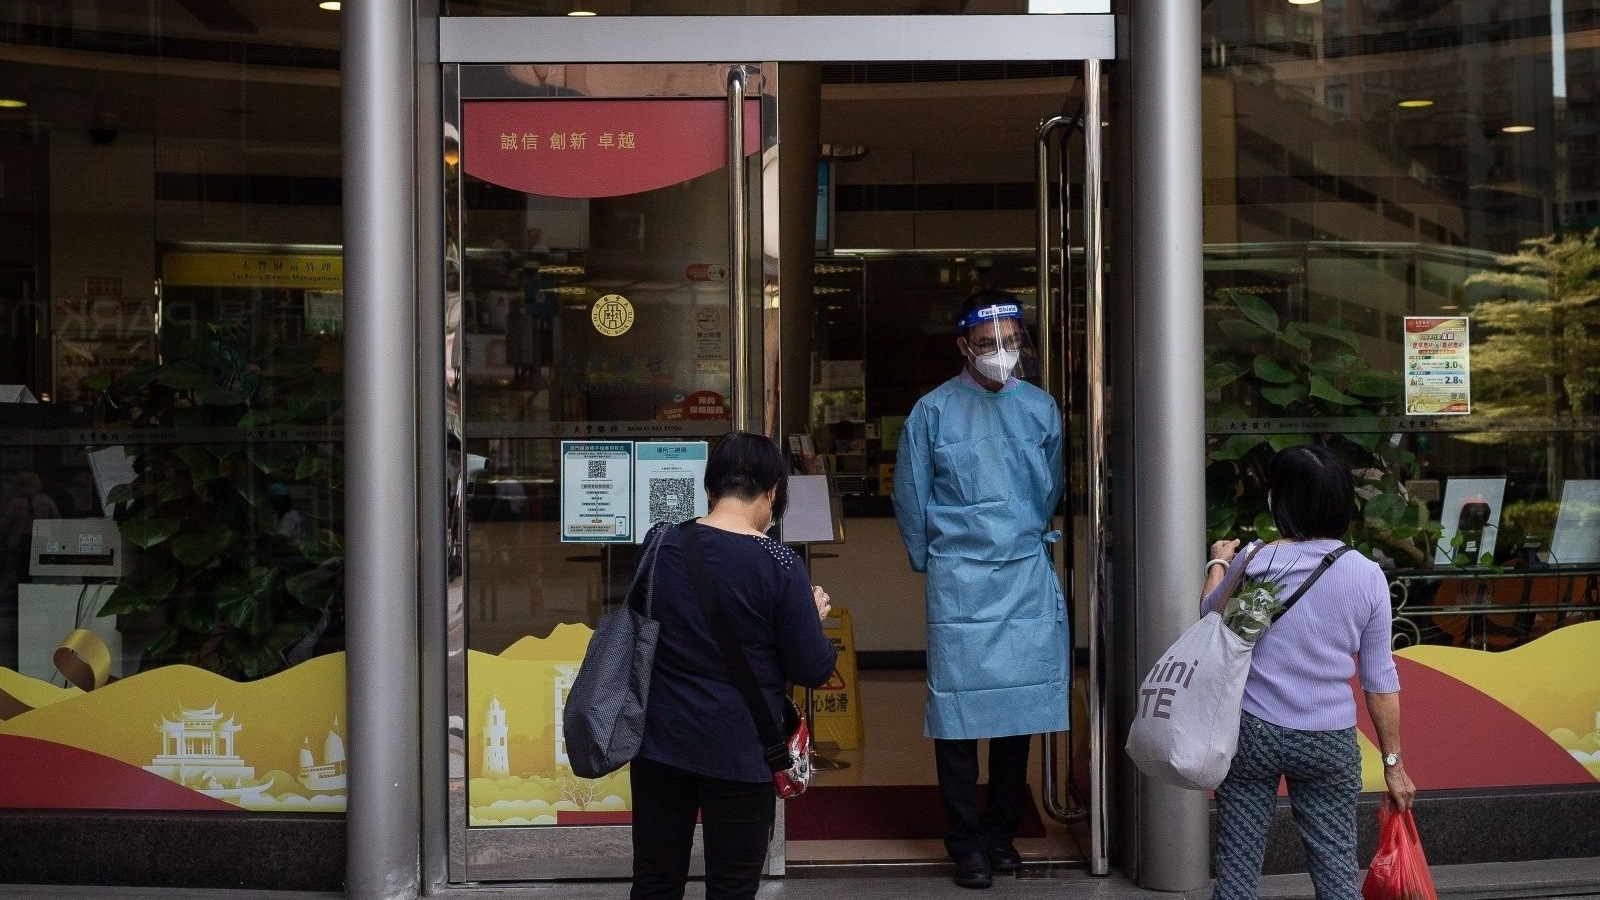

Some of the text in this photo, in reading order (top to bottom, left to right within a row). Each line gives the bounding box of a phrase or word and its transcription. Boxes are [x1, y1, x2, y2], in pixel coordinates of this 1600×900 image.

[500, 131, 636, 150] 誠信 創新 卓越
